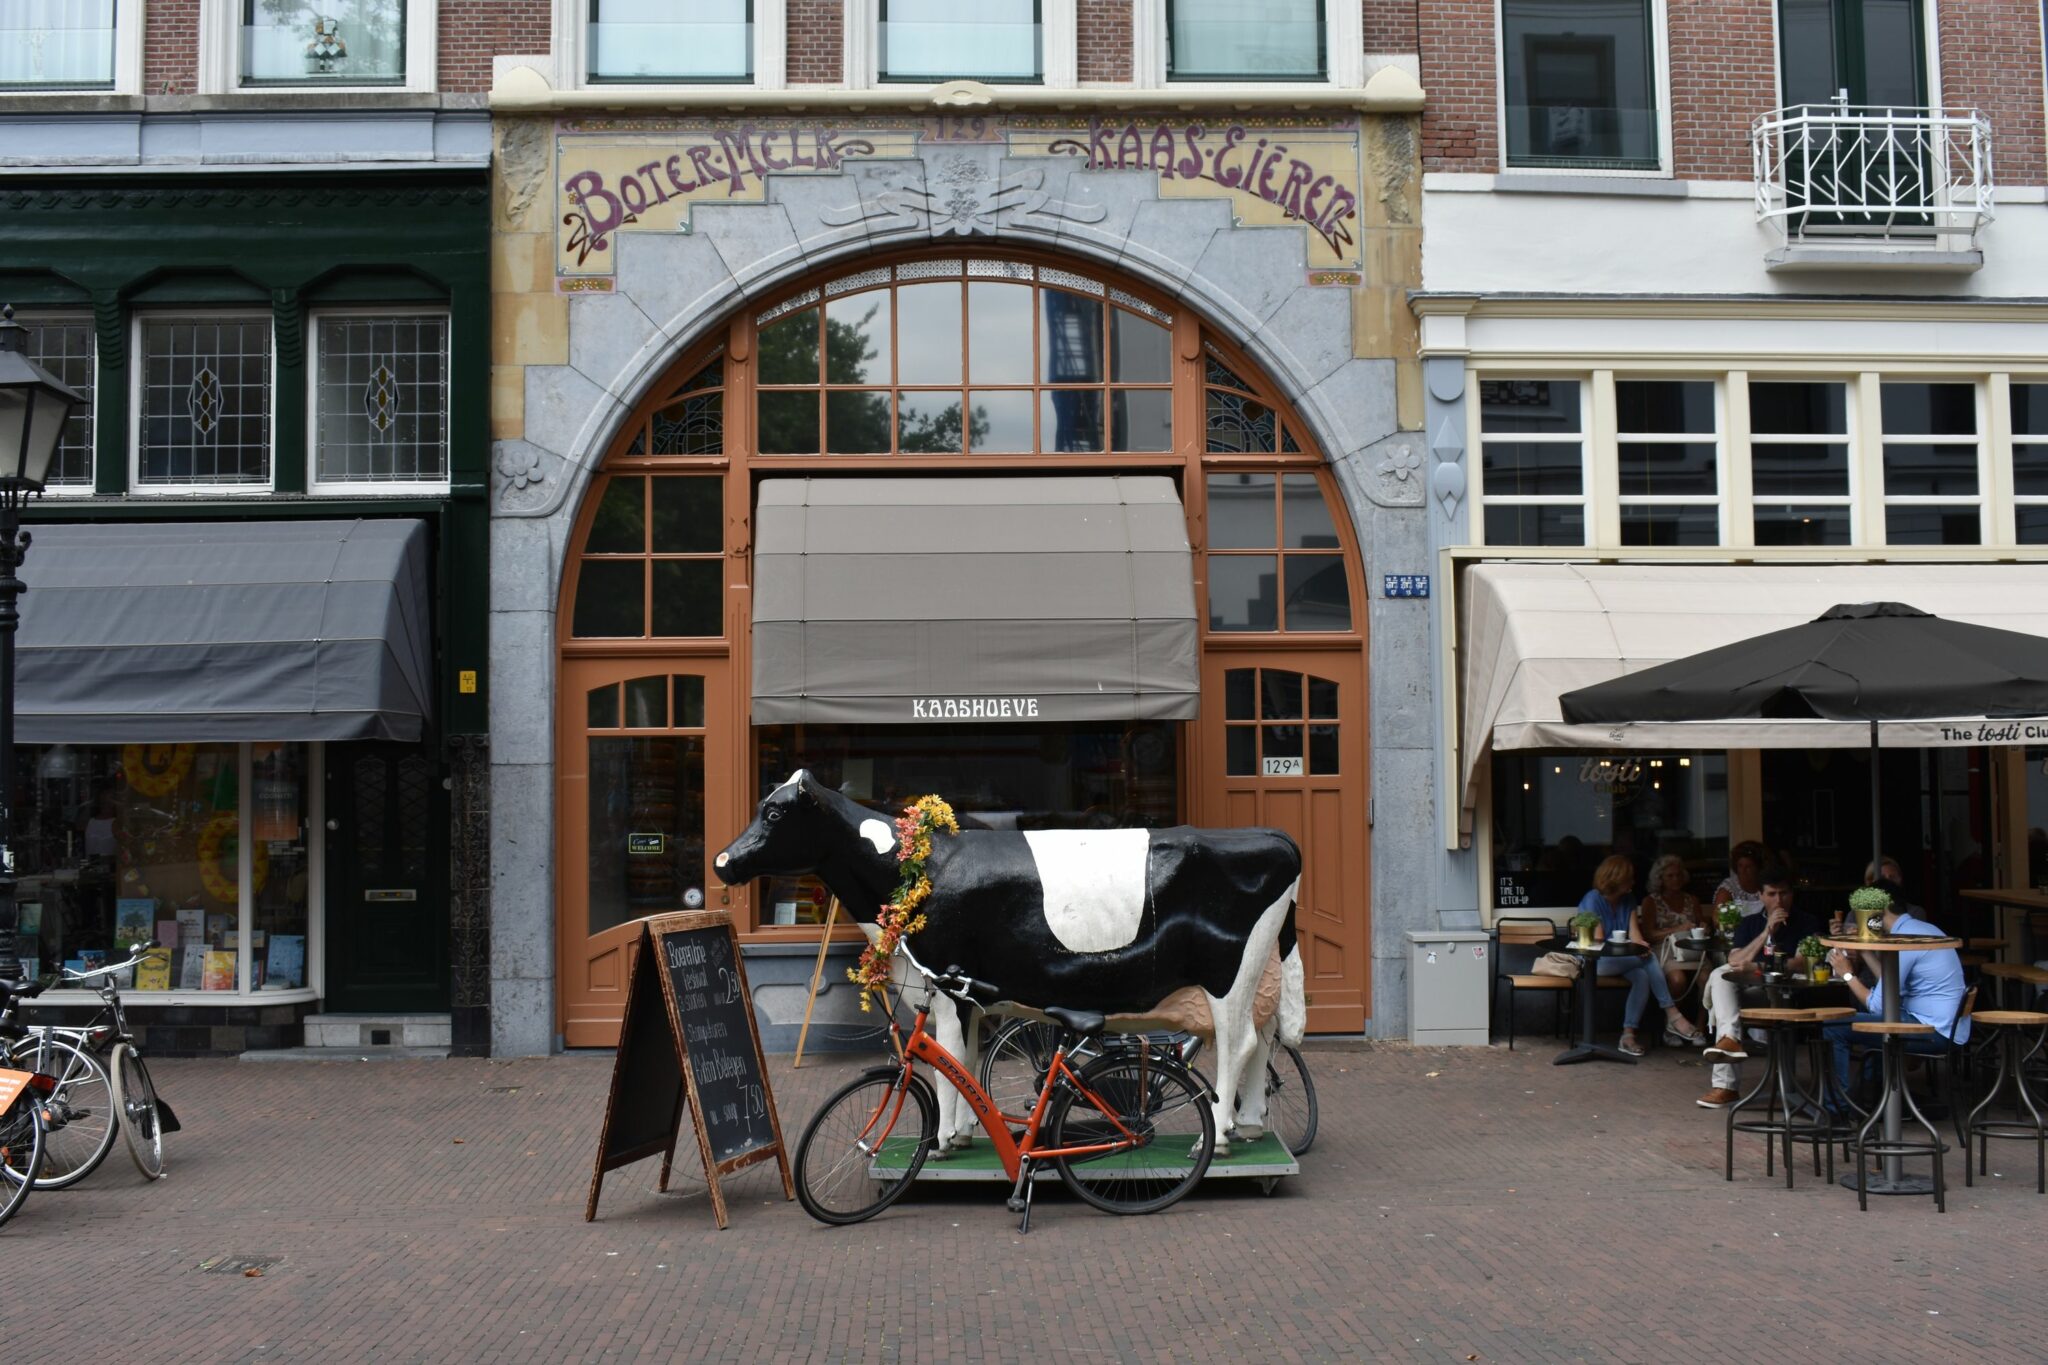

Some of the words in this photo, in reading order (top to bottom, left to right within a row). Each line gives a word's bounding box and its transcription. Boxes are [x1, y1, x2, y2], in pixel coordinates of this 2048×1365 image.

[936, 115, 985, 139] 129
[912, 698, 1039, 718] KAASHOEVE
[1940, 728, 1973, 741] The
[1977, 722, 2021, 741] tosti
[1579, 756, 1641, 782] tosti
[1500, 886, 1513, 896] TIME
[1516, 886, 1525, 895] TO
[937, 1056, 988, 1114] SPARTA
